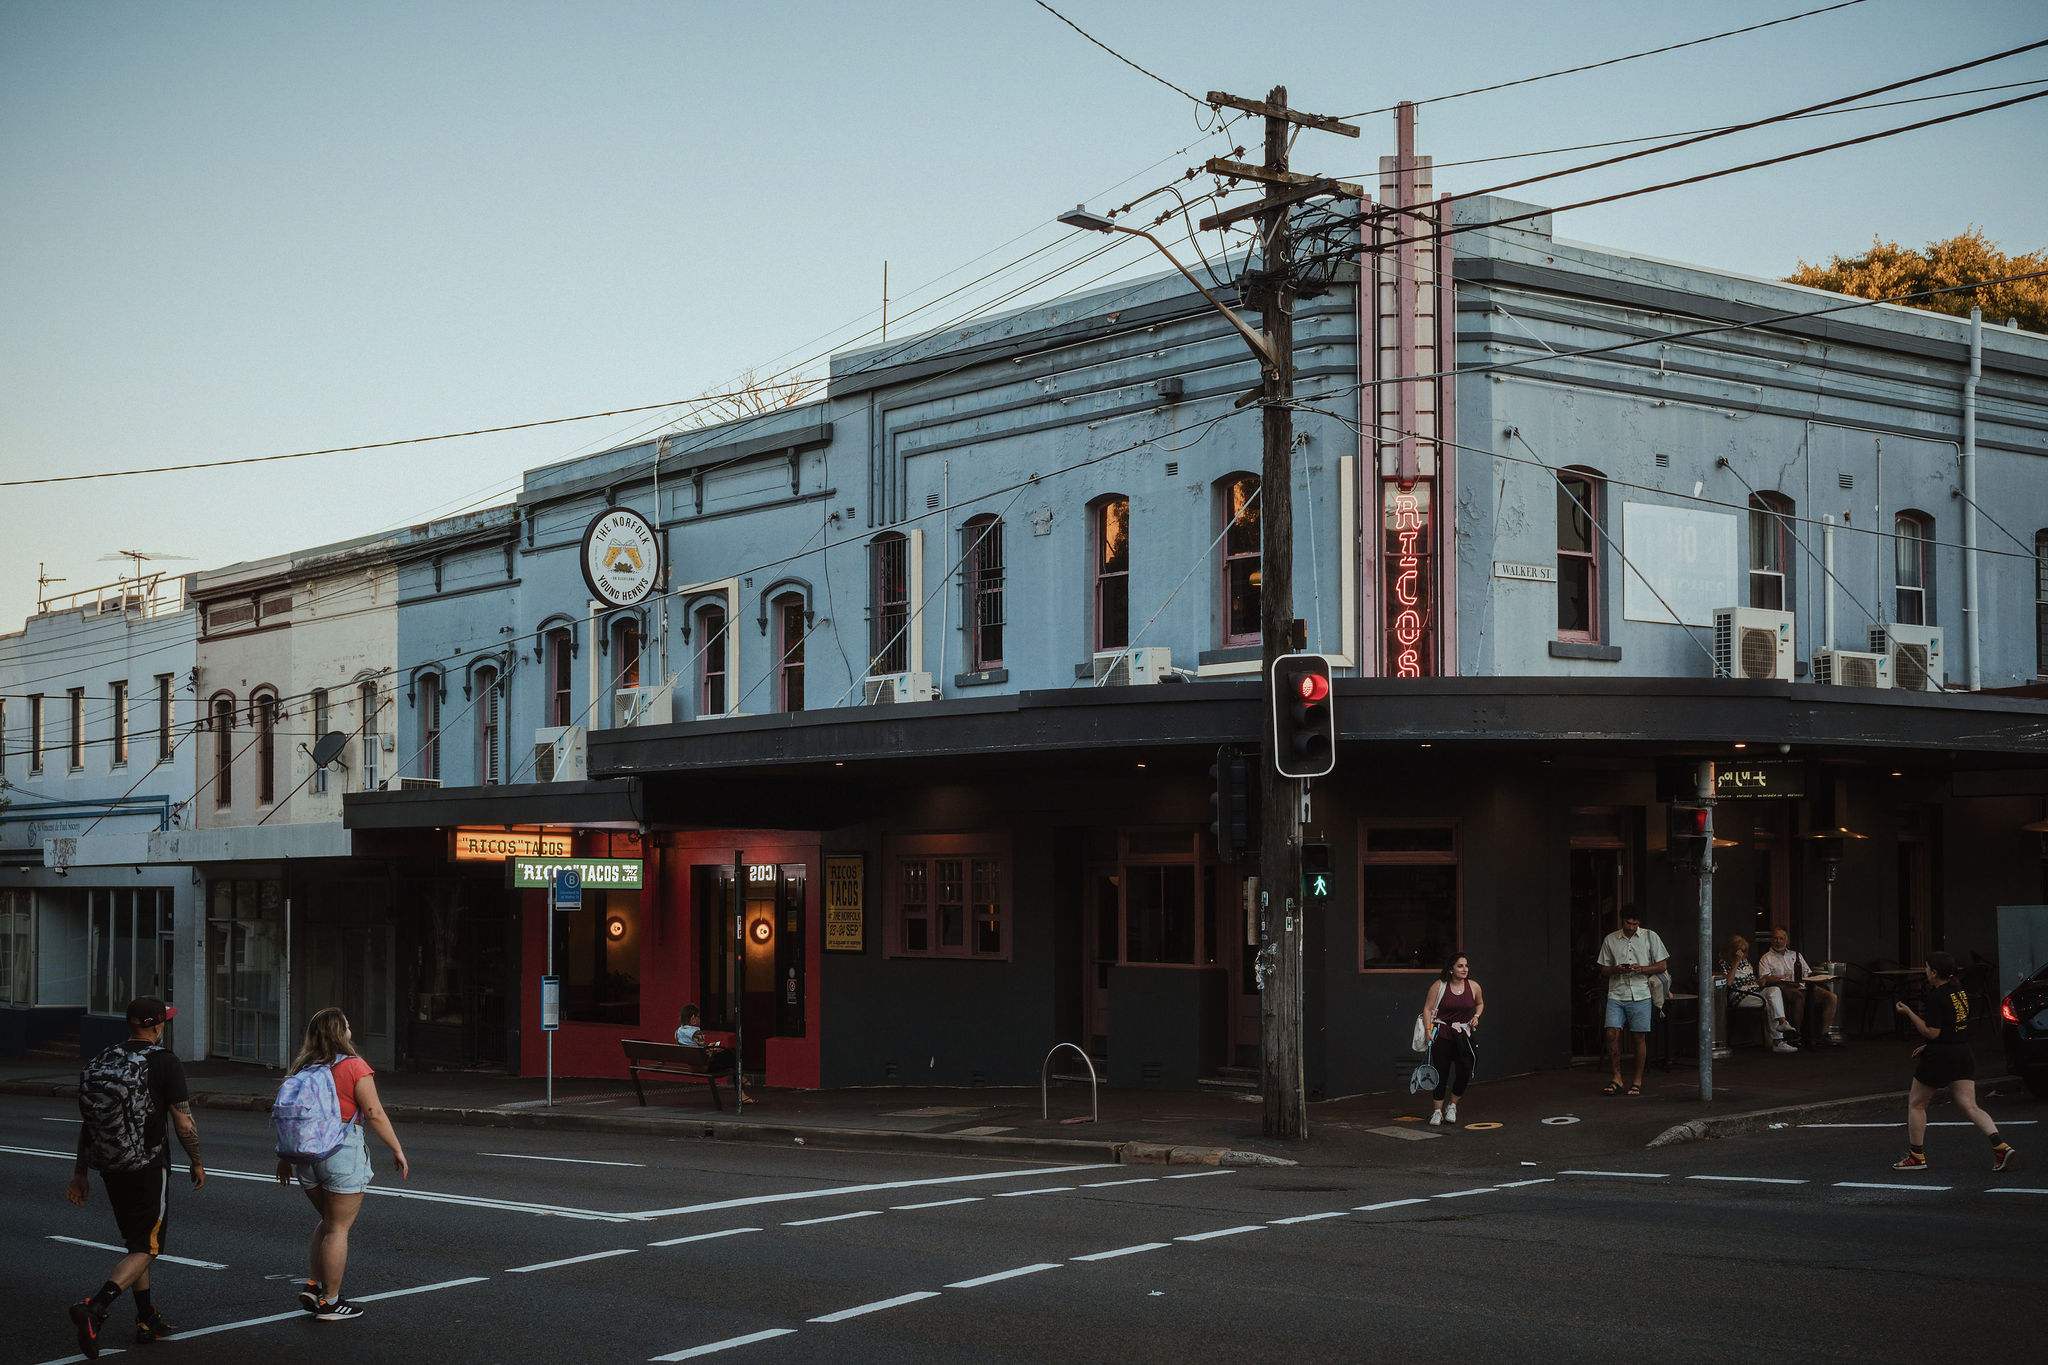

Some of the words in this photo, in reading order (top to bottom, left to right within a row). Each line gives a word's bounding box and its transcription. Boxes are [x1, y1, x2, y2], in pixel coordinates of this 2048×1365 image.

[595, 523, 612, 542] THE
[612, 516, 650, 545] NORFOLK
[1502, 564, 1538, 578] WALKER
[598, 574, 620, 600] YOUNG
[622, 577, 649, 601] HENRYS
[525, 841, 563, 856] TACOS
[517, 863, 580, 881] "RIC"
[580, 865, 620, 882] TACOS
[830, 880, 859, 906] TACOS
[841, 911, 861, 921] NORFOLK
